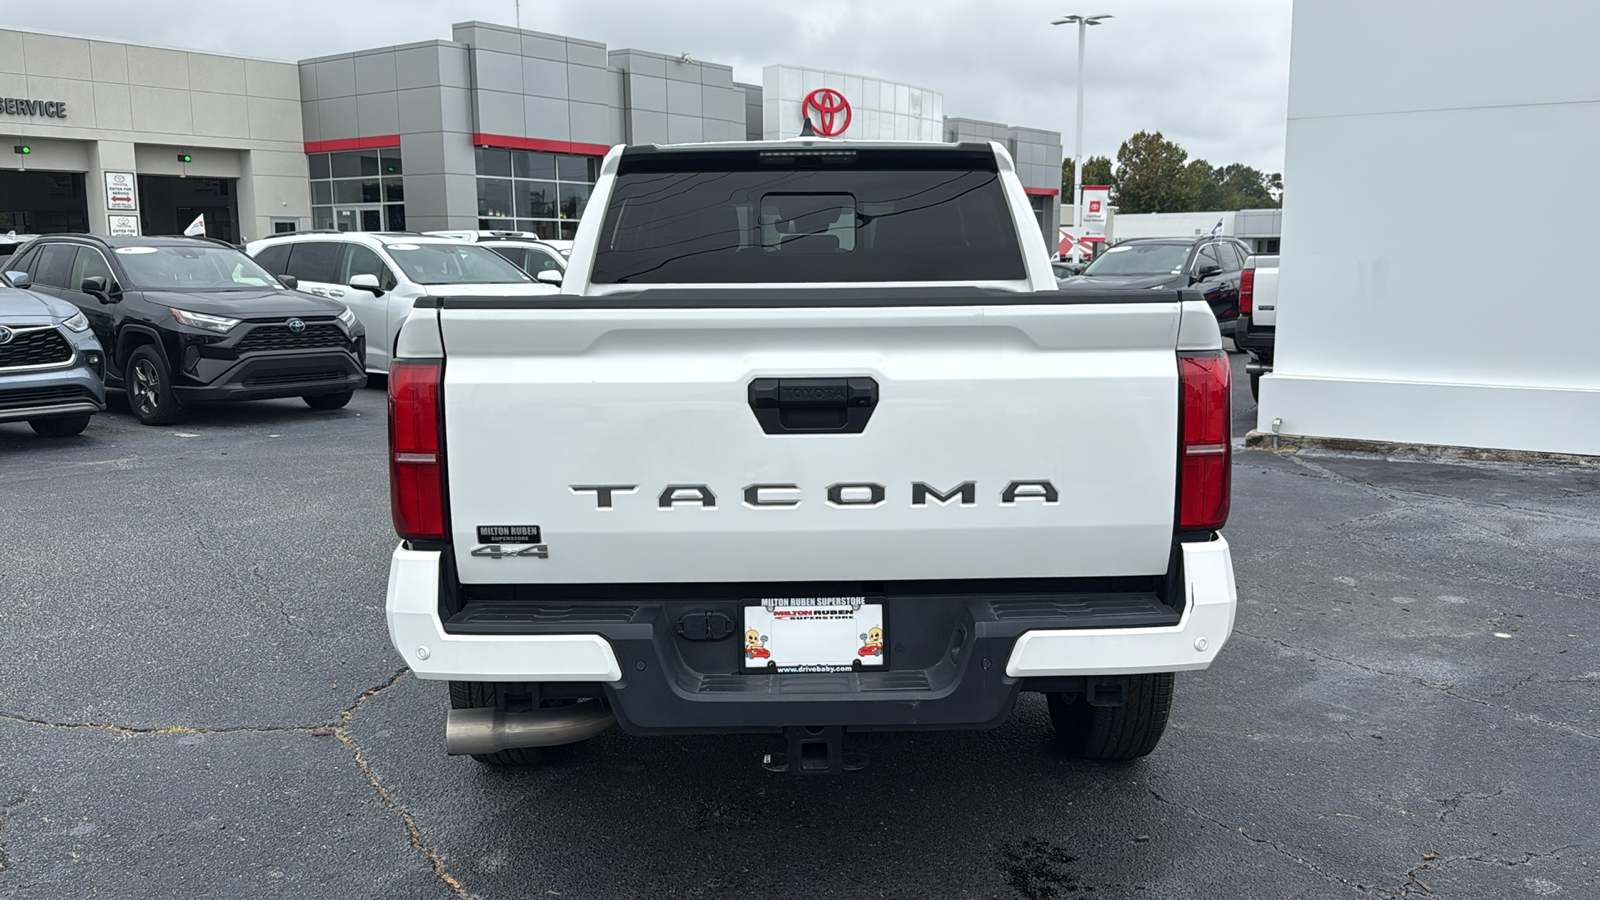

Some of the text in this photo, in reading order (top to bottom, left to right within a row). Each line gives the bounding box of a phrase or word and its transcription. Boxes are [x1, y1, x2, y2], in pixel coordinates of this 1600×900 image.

[783, 388, 845, 400] TOYOTA
[568, 479, 1060, 510] TACOMA
[480, 526, 537, 536] MILTON RUBEN
[761, 596, 866, 606] MILTON RUBEN SUPERSTORE
[777, 665, 852, 674] www.drivebaby.com
